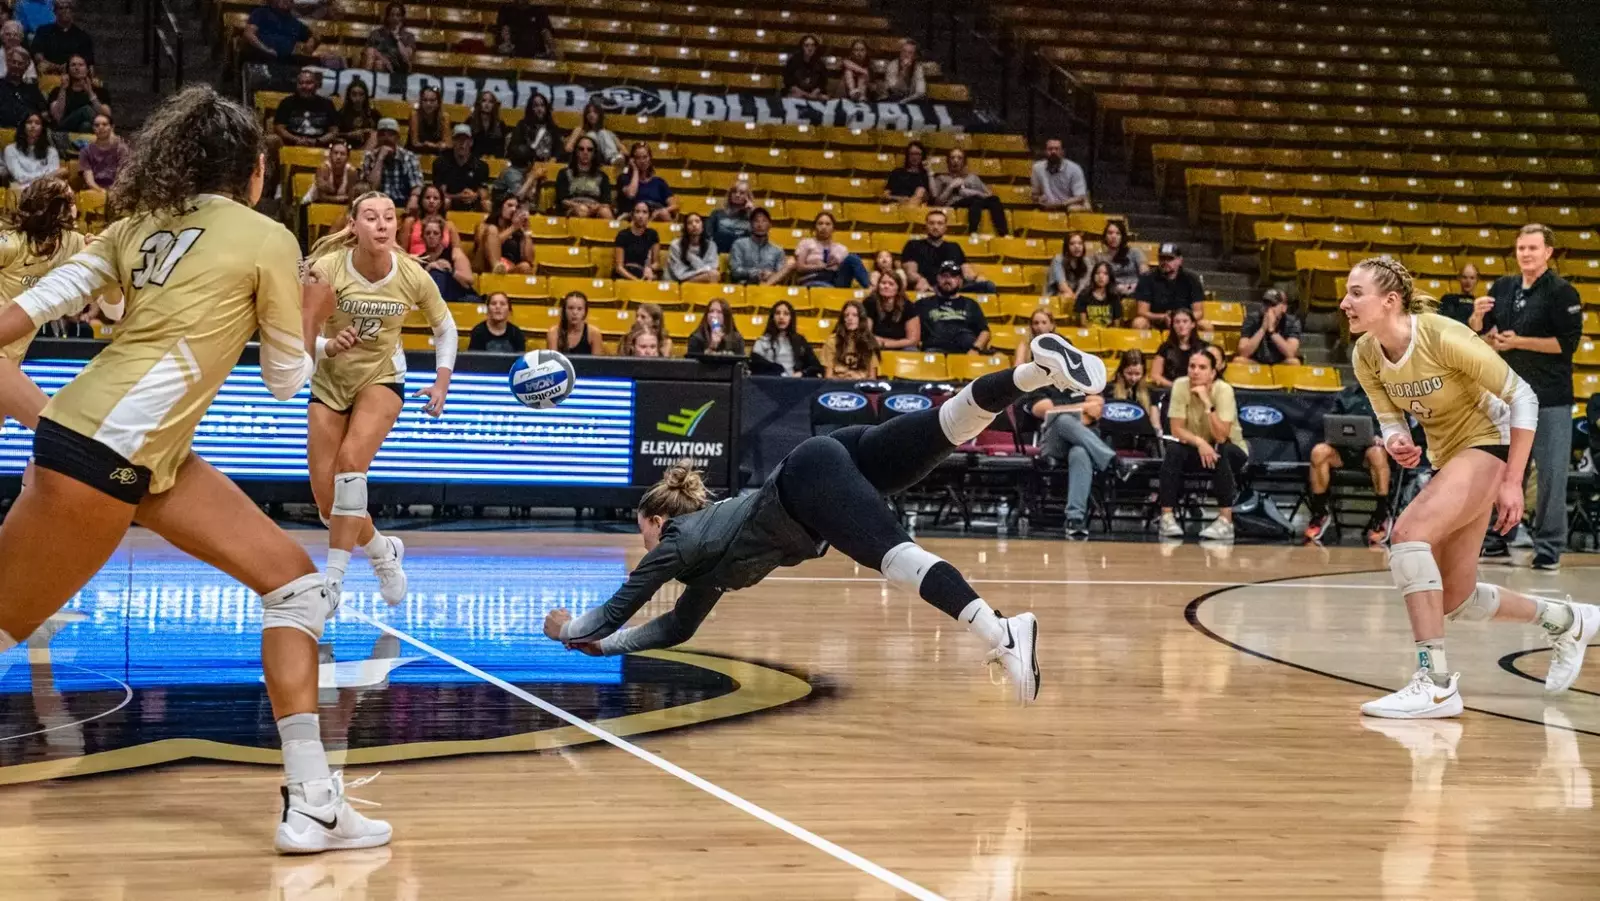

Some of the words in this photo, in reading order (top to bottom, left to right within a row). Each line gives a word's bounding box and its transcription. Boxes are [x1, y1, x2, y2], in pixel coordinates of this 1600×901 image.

[658, 89, 964, 133] VOLLEYBALL
[131, 227, 206, 289] 31
[352, 317, 383, 341] 12
[525, 386, 561, 401] molten
[1386, 376, 1443, 397] LORADO
[827, 395, 858, 408] Ford
[893, 397, 924, 410] Ford
[1410, 400, 1432, 419] 4
[1105, 404, 1134, 418] Ford
[1245, 407, 1274, 423] Ford
[640, 440, 723, 457] ELEVATIONS
